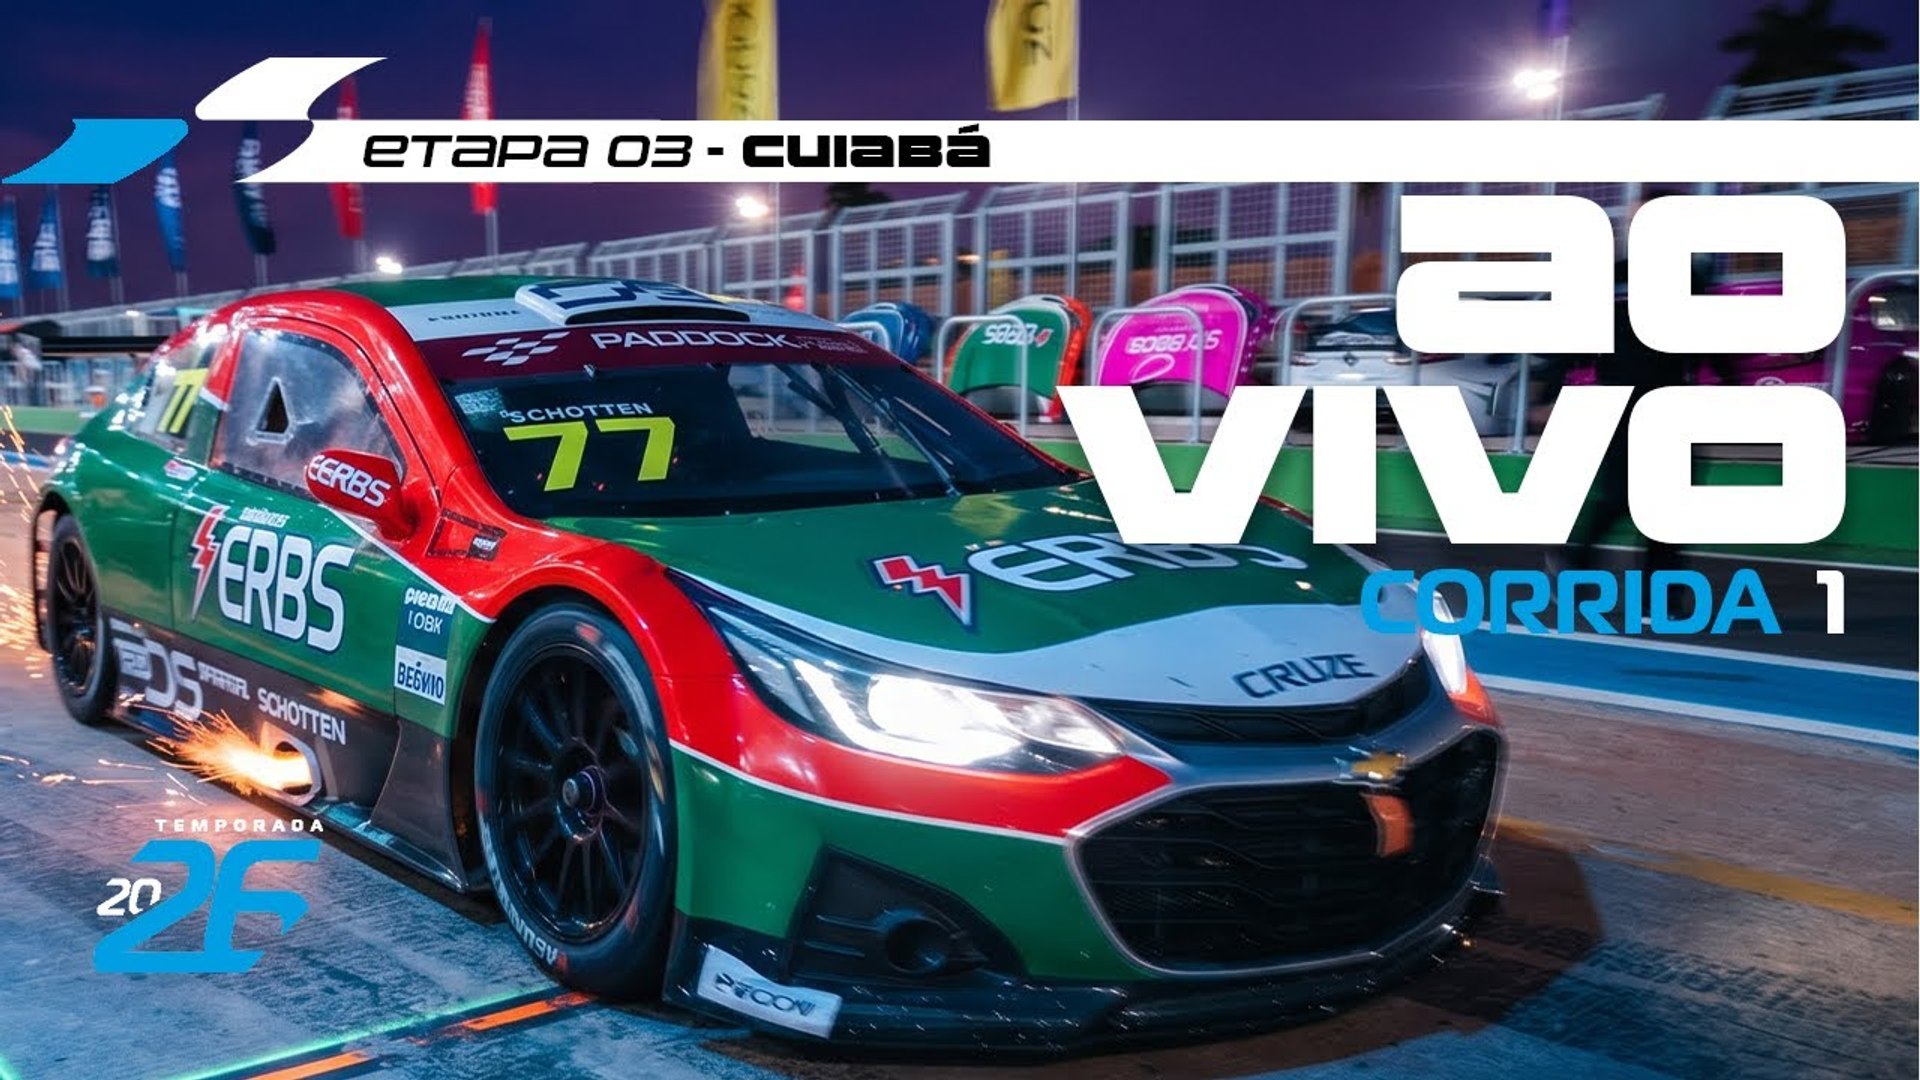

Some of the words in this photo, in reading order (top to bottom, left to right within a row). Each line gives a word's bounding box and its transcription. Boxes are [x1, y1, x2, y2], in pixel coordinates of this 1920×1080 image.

[590, 331, 802, 349] PADDOCK
[509, 402, 654, 423] SCHOTTEN
[503, 416, 677, 492] 77
[218, 524, 355, 653] ERBS
[1232, 653, 1380, 699] CRUZE
[257, 687, 347, 745] SCHOTTEN
